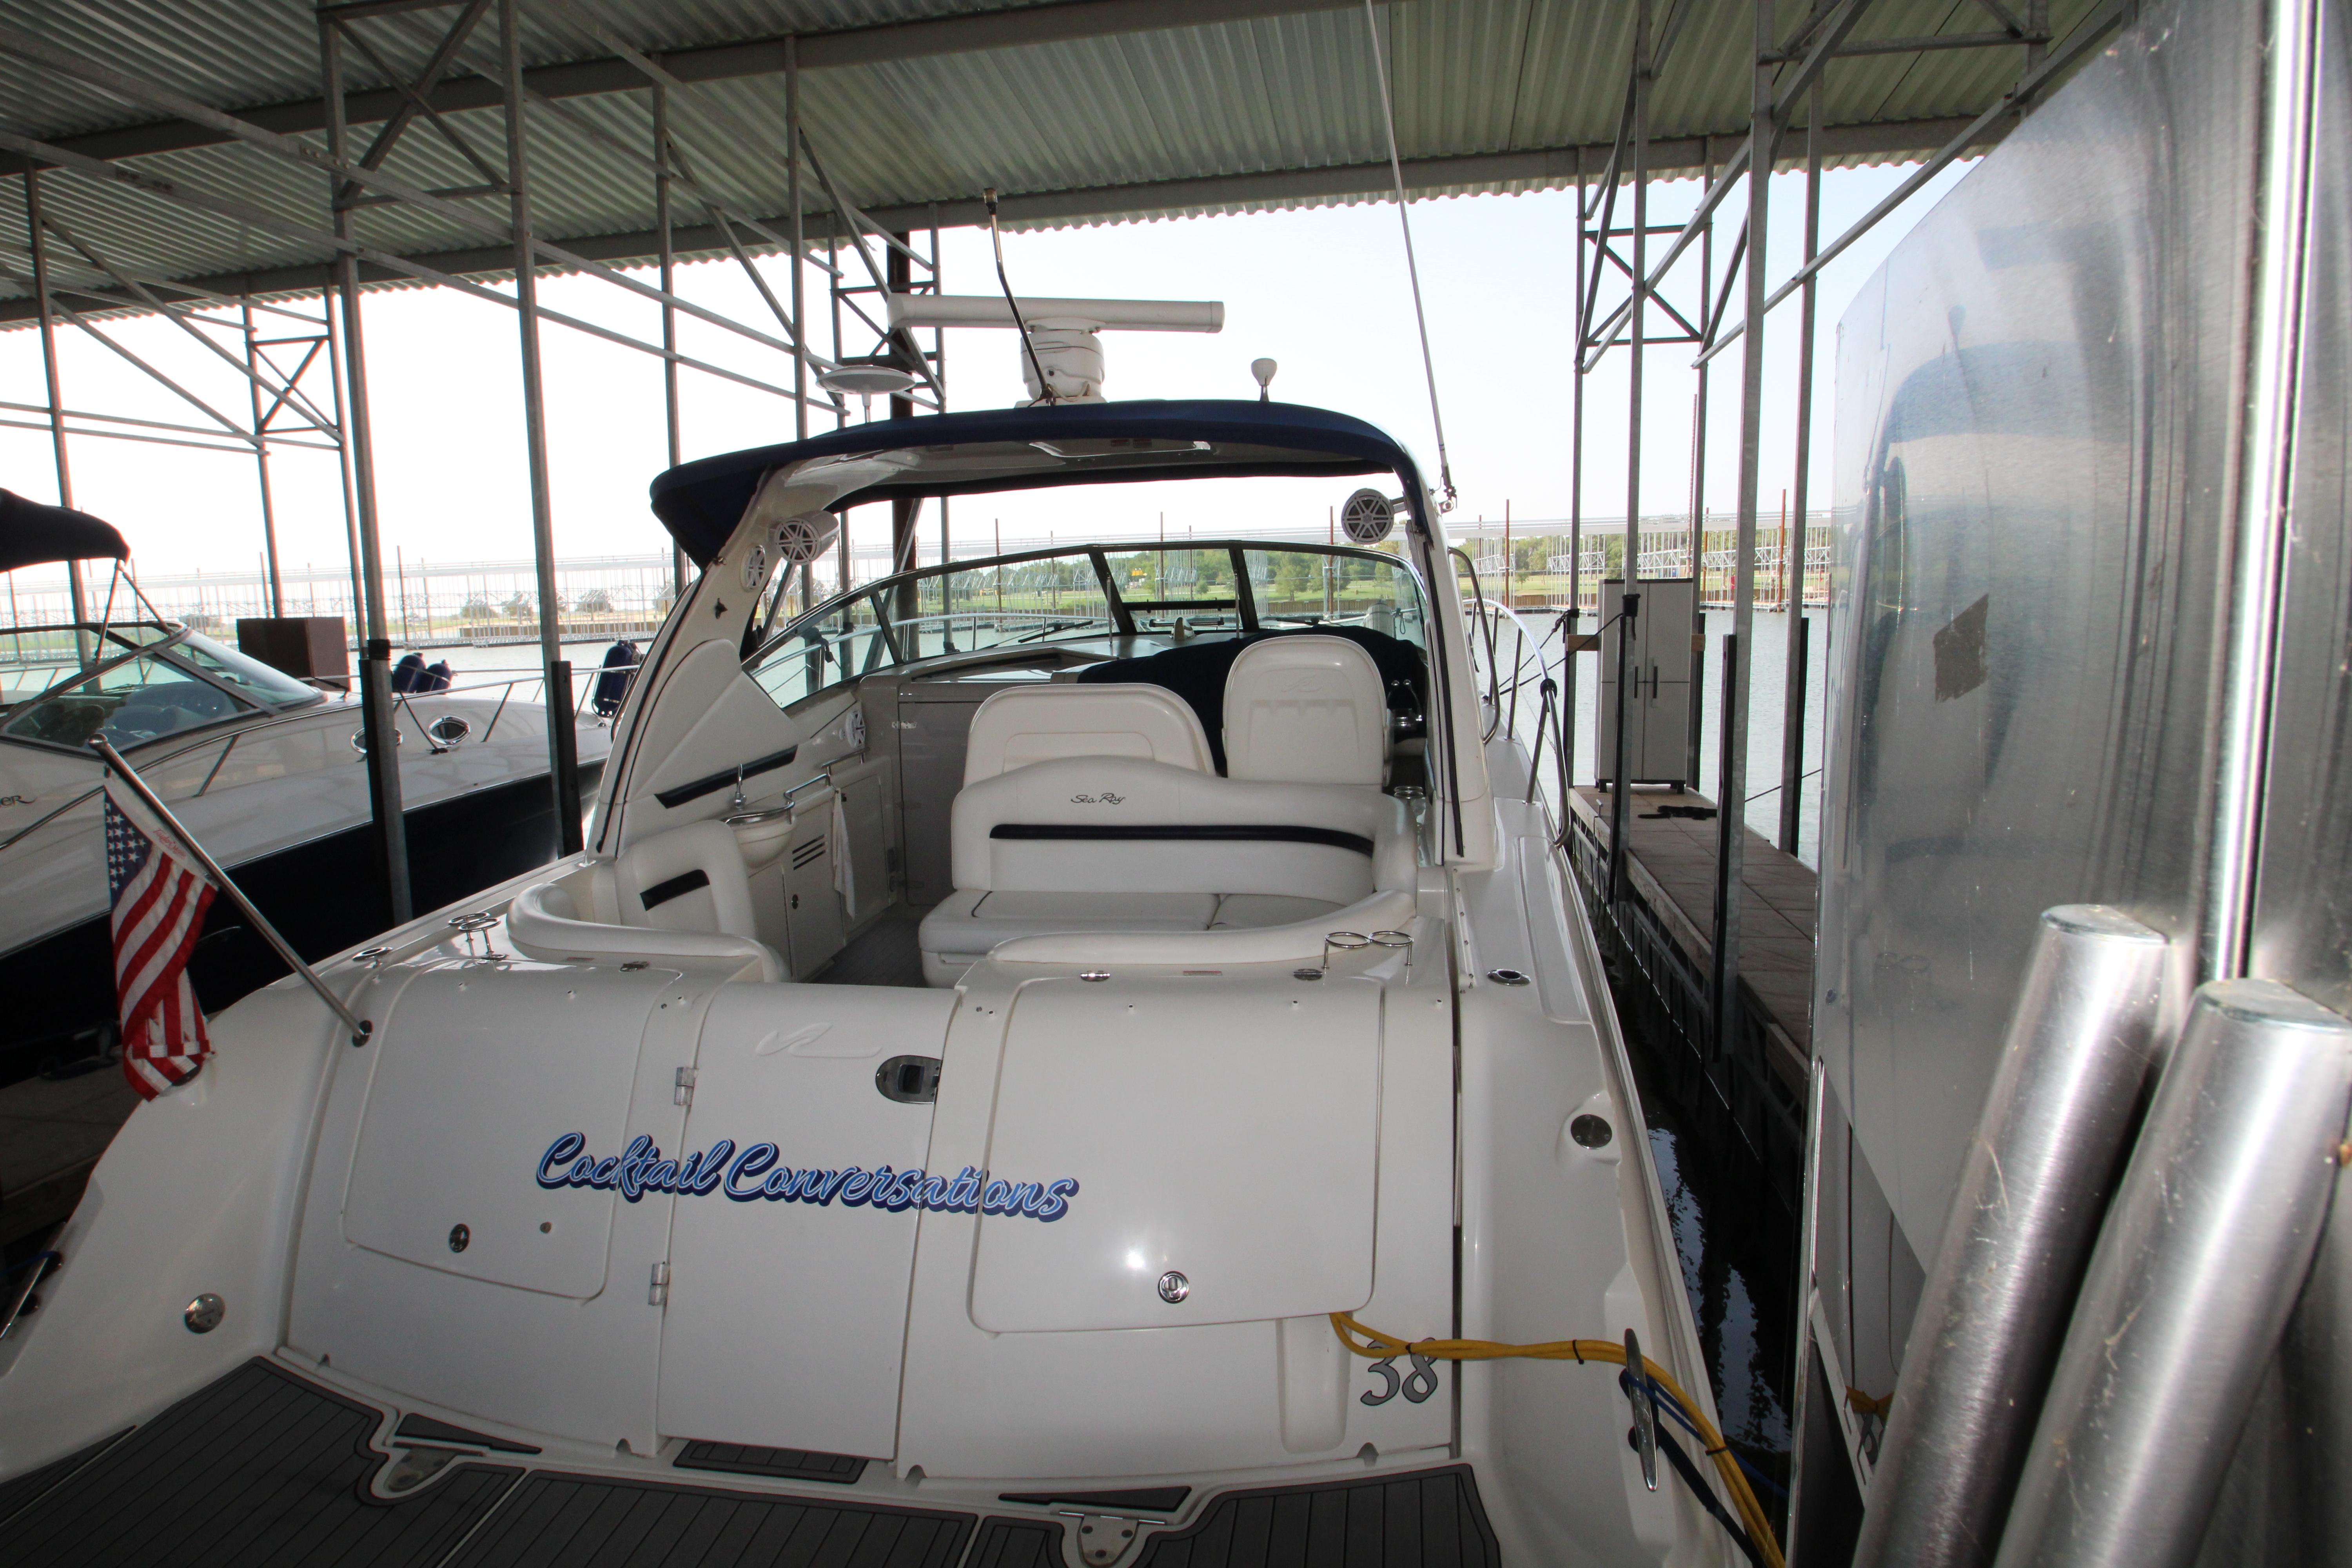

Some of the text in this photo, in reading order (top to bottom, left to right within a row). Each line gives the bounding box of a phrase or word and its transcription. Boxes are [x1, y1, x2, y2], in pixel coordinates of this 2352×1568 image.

[1071, 793, 1125, 804] Sea Ray
[536, 1132, 1080, 1223] Cocktail Conversations
[1360, 1337, 1438, 1406] 38
